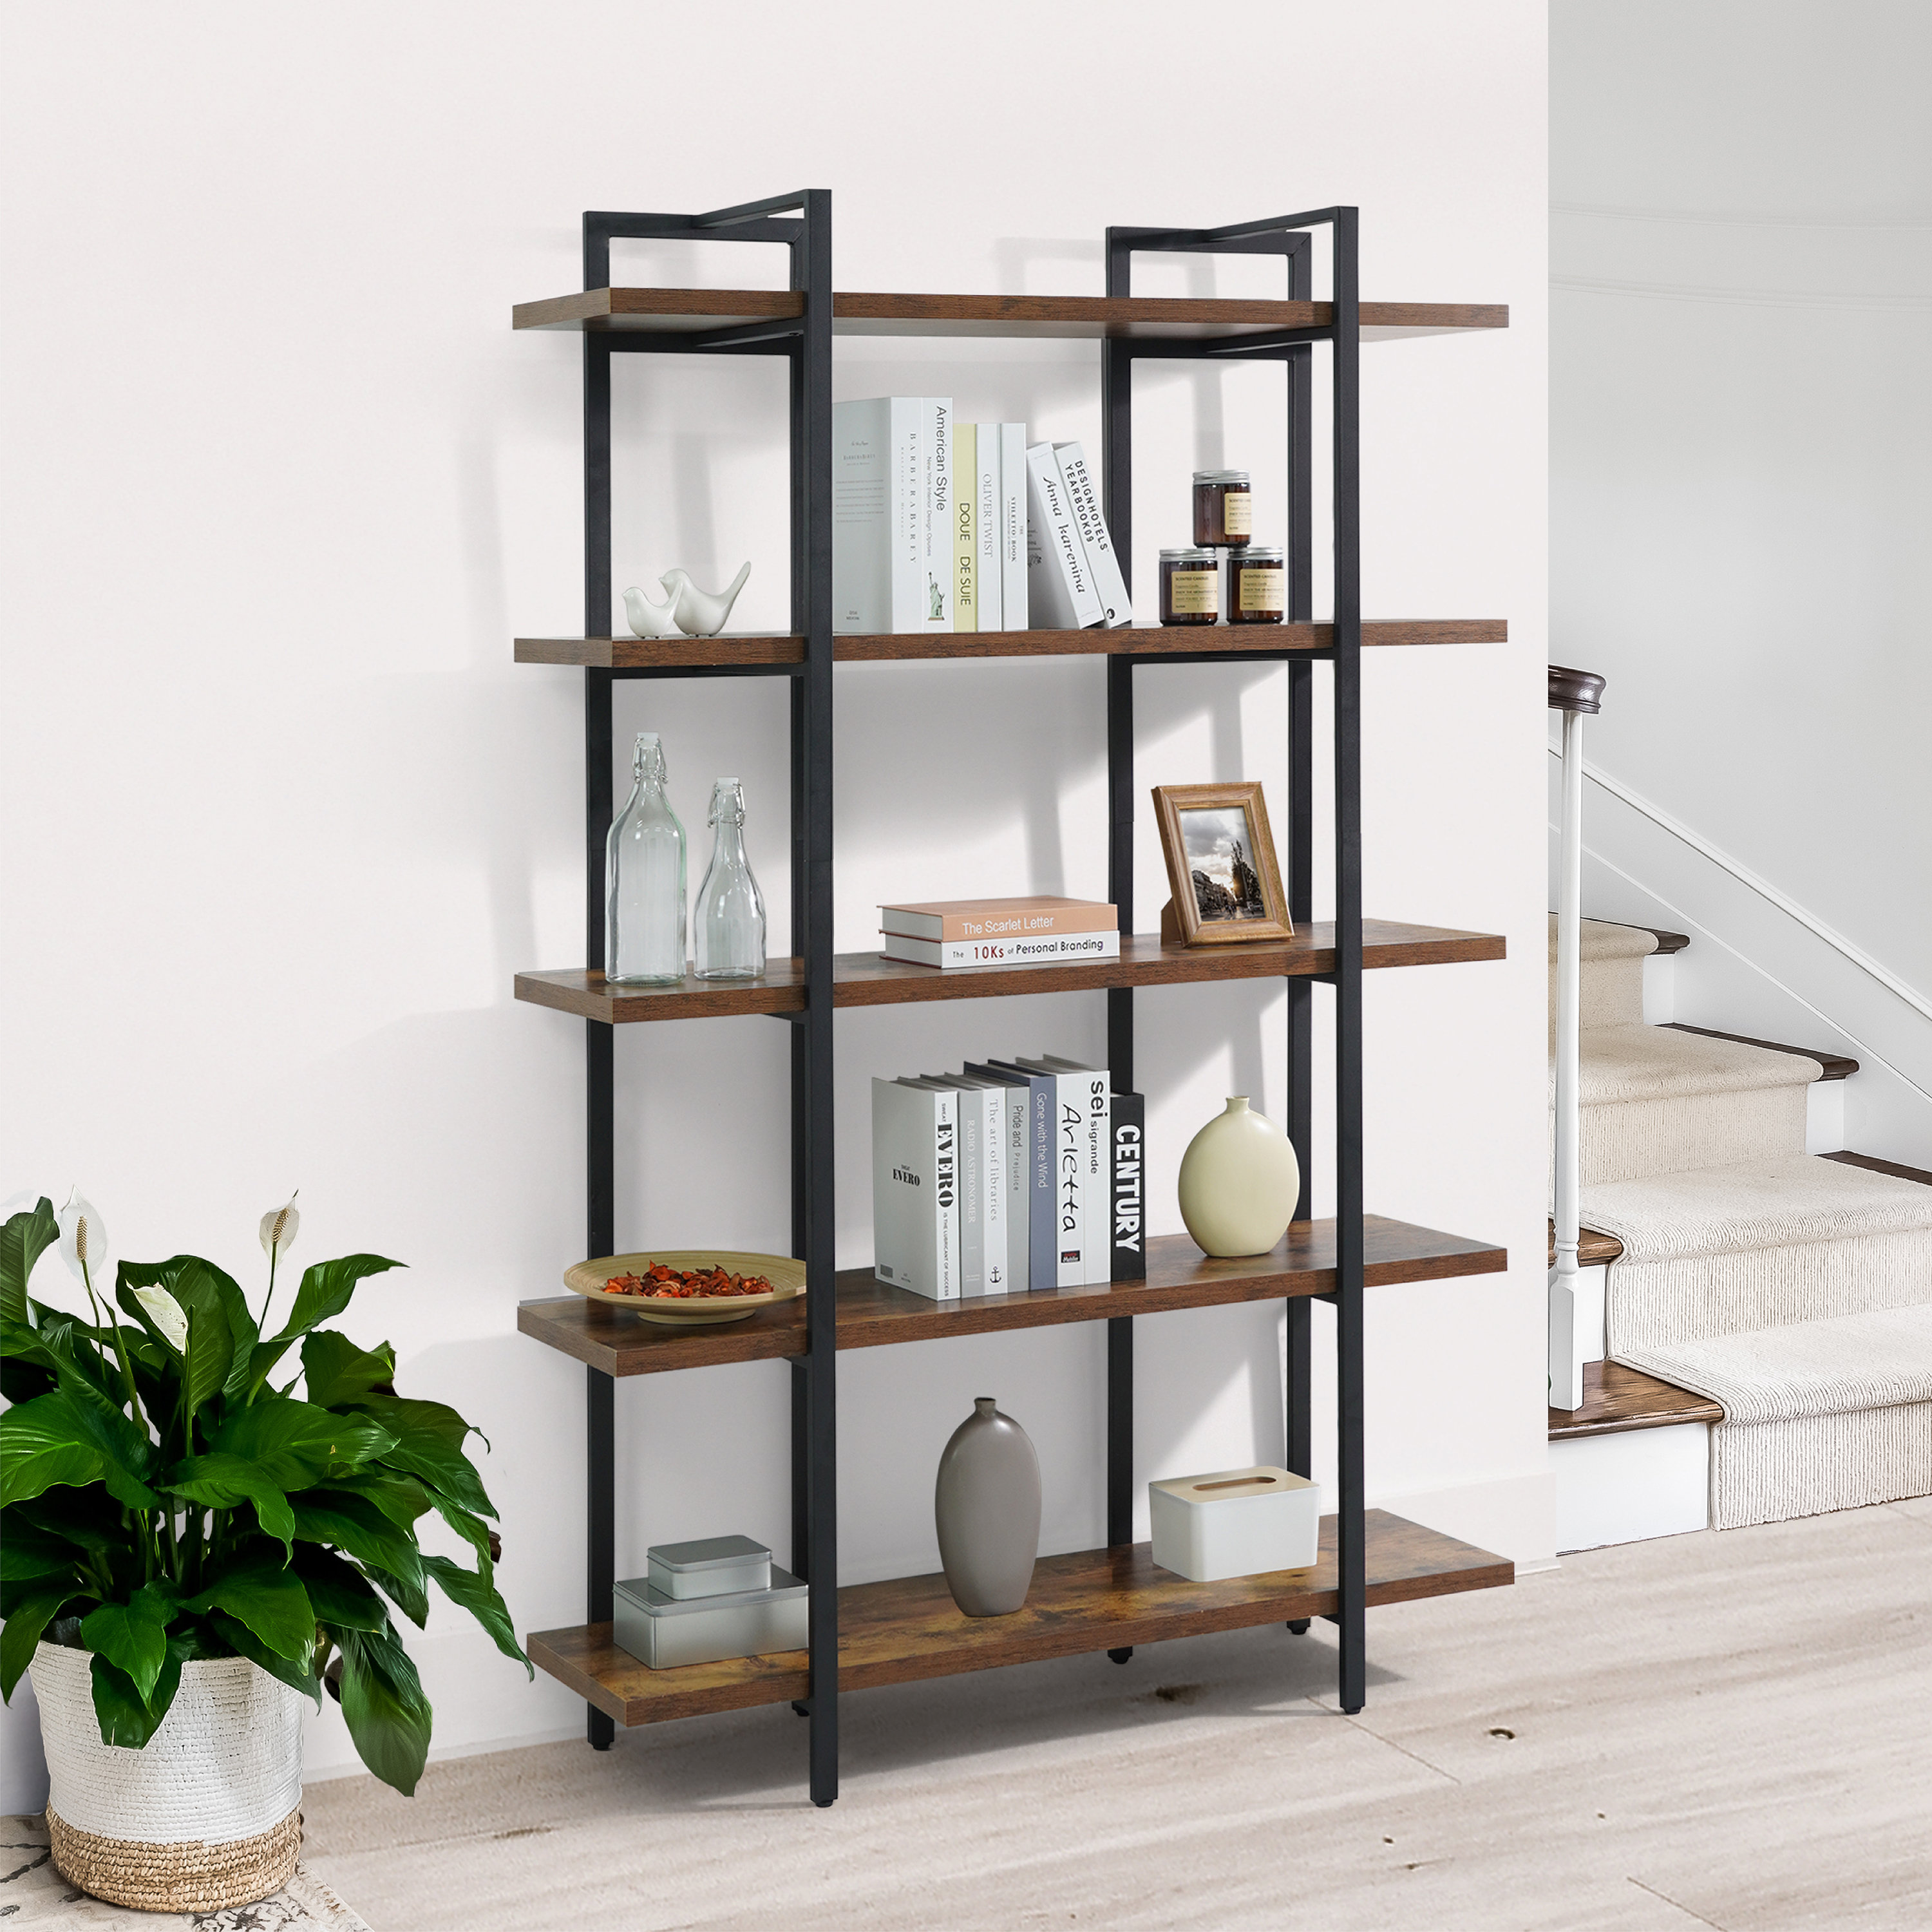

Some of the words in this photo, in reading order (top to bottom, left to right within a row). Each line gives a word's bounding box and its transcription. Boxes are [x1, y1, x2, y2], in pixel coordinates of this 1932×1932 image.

[936, 406, 947, 471] American
[934, 477, 947, 511] Style
[983, 473, 992, 518] OLIVER
[960, 503, 971, 541] DOUE
[1043, 477, 1062, 516] Anna
[1058, 524, 1085, 592] karenina
[984, 520, 993, 558] TWIST
[960, 556, 971, 574] DE
[960, 578, 971, 605] SUIE
[962, 922, 982, 934] The
[985, 918, 1021, 933] Scarlet
[1024, 916, 1054, 929] Letter
[974, 945, 1005, 959] 10Ks
[1016, 942, 1057, 954] Personal
[1061, 939, 1103, 951] Branding
[989, 1099, 998, 1124] The
[1012, 1104, 1023, 1129] Pride
[1036, 1092, 1047, 1119] Gone
[967, 1119, 976, 1151] RADIO
[1012, 1131, 1023, 1147] and
[1037, 1121, 1047, 1143] with
[938, 1123, 954, 1208] EVERO
[990, 1150, 999, 1164] of
[1037, 1144, 1047, 1160] the
[893, 1168, 920, 1187] EVERO
[1037, 1163, 1048, 1188] Wind
[1061, 1103, 1081, 1232] Arletta
[967, 1154, 976, 1224] ASTRONOMER
[990, 1168, 999, 1221] libraries
[1115, 1124, 1141, 1253] CENTURY
